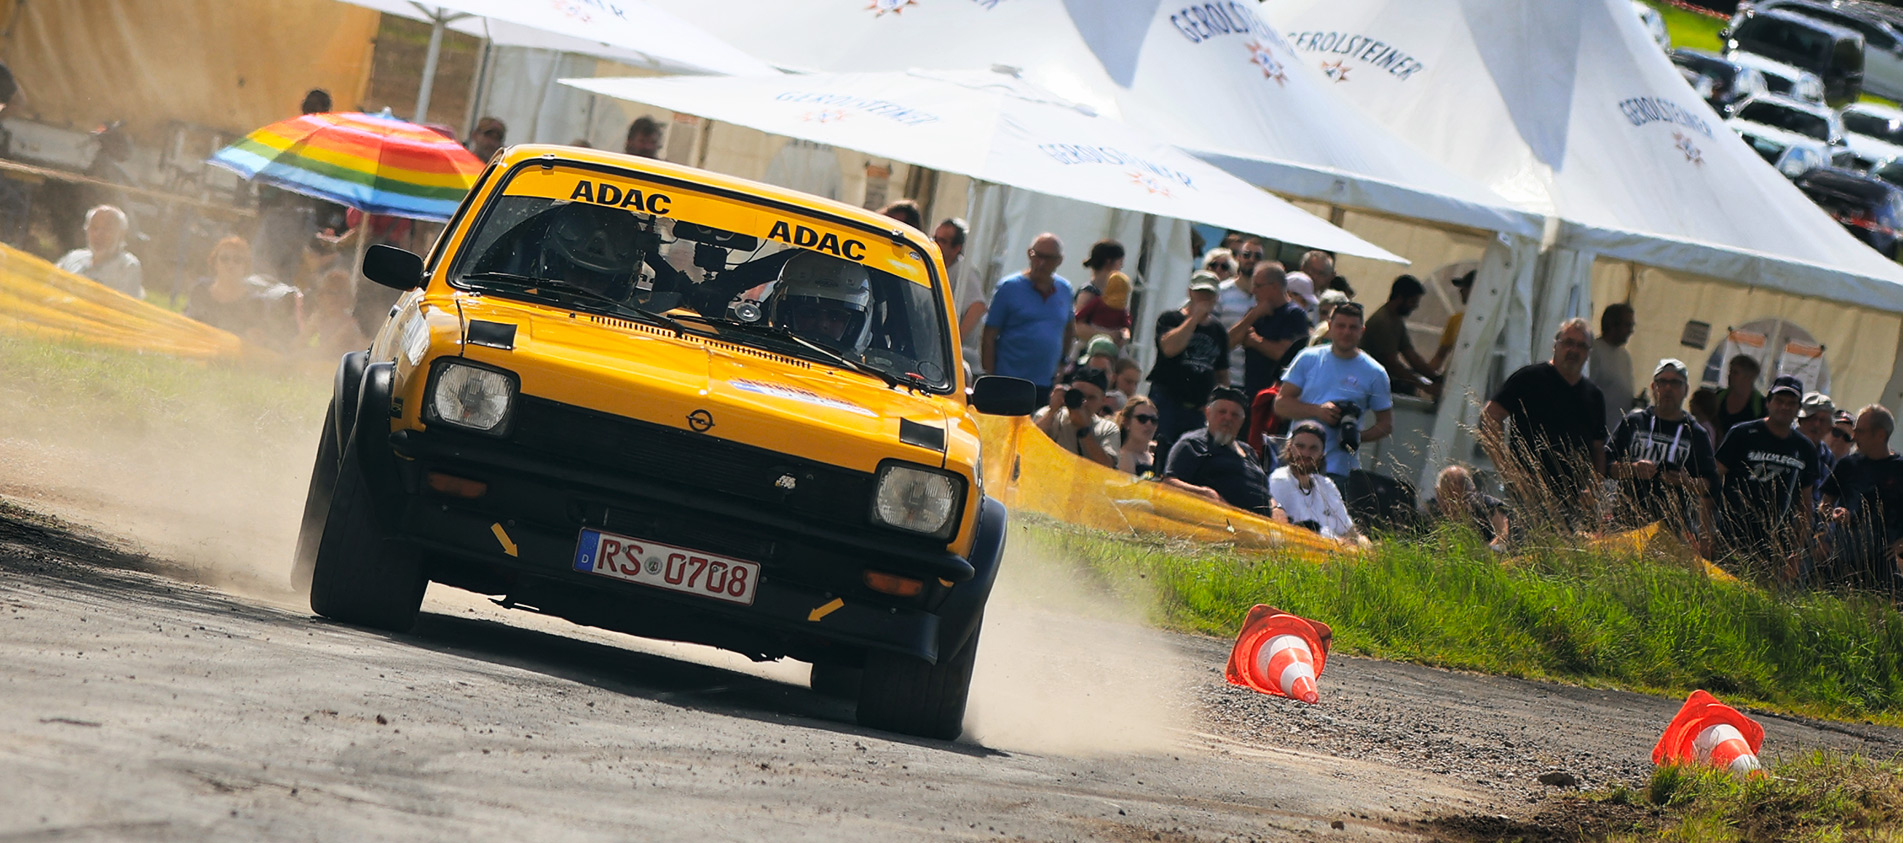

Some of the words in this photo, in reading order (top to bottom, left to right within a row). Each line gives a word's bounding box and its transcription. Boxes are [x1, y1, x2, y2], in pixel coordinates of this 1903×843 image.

[1170, 1, 1298, 59] GEROLS
[570, 180, 672, 215] ADAC
[767, 220, 867, 262] ADAC
[581, 554, 589, 564] D
[597, 539, 644, 576] RS
[664, 553, 748, 597] 0708
